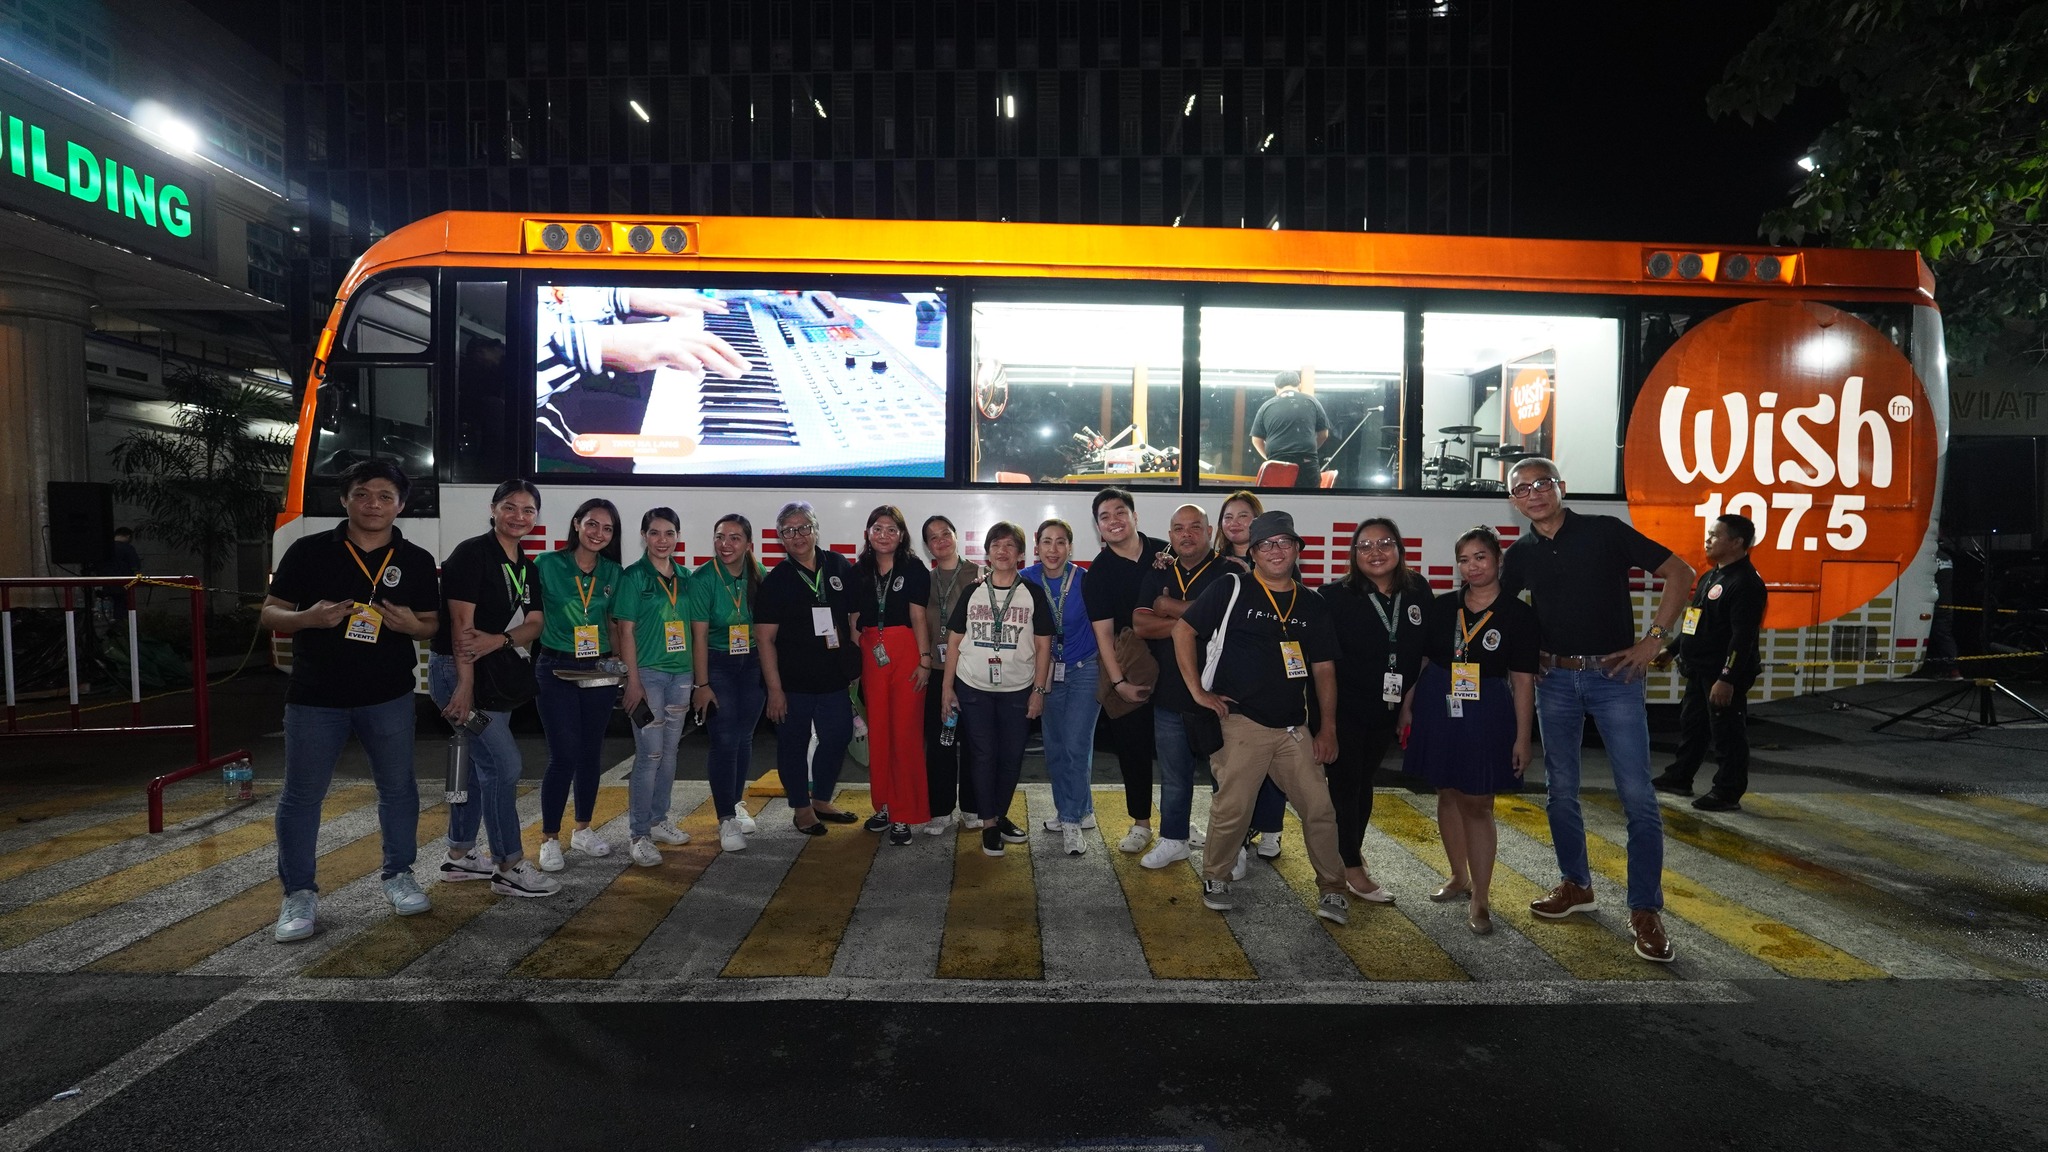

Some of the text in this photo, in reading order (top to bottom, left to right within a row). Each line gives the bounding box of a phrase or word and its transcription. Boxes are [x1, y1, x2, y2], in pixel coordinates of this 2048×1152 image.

[0, 111, 191, 237] ILDING
[1891, 401, 1911, 416] fm
[348, 632, 375, 641] EVENTS
